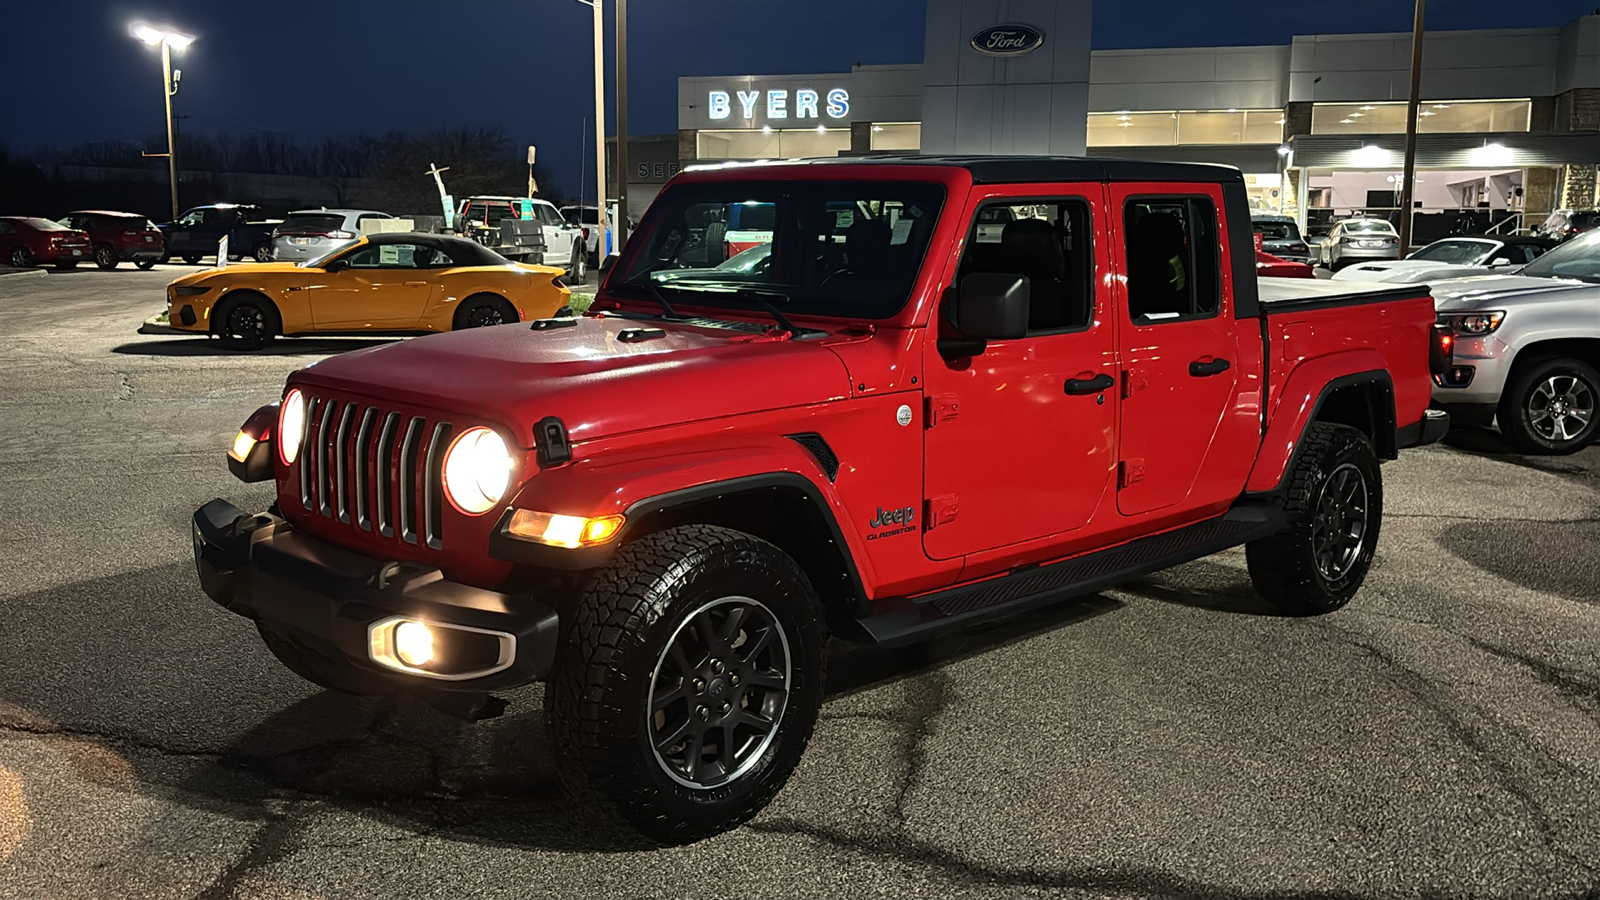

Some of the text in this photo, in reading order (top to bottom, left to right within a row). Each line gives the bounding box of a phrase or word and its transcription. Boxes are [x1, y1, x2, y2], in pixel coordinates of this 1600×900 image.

[986, 31, 1027, 48] Ford
[708, 88, 849, 120] BYERS
[870, 506, 915, 529] Jeep
[866, 525, 916, 541] GLADIATOR
